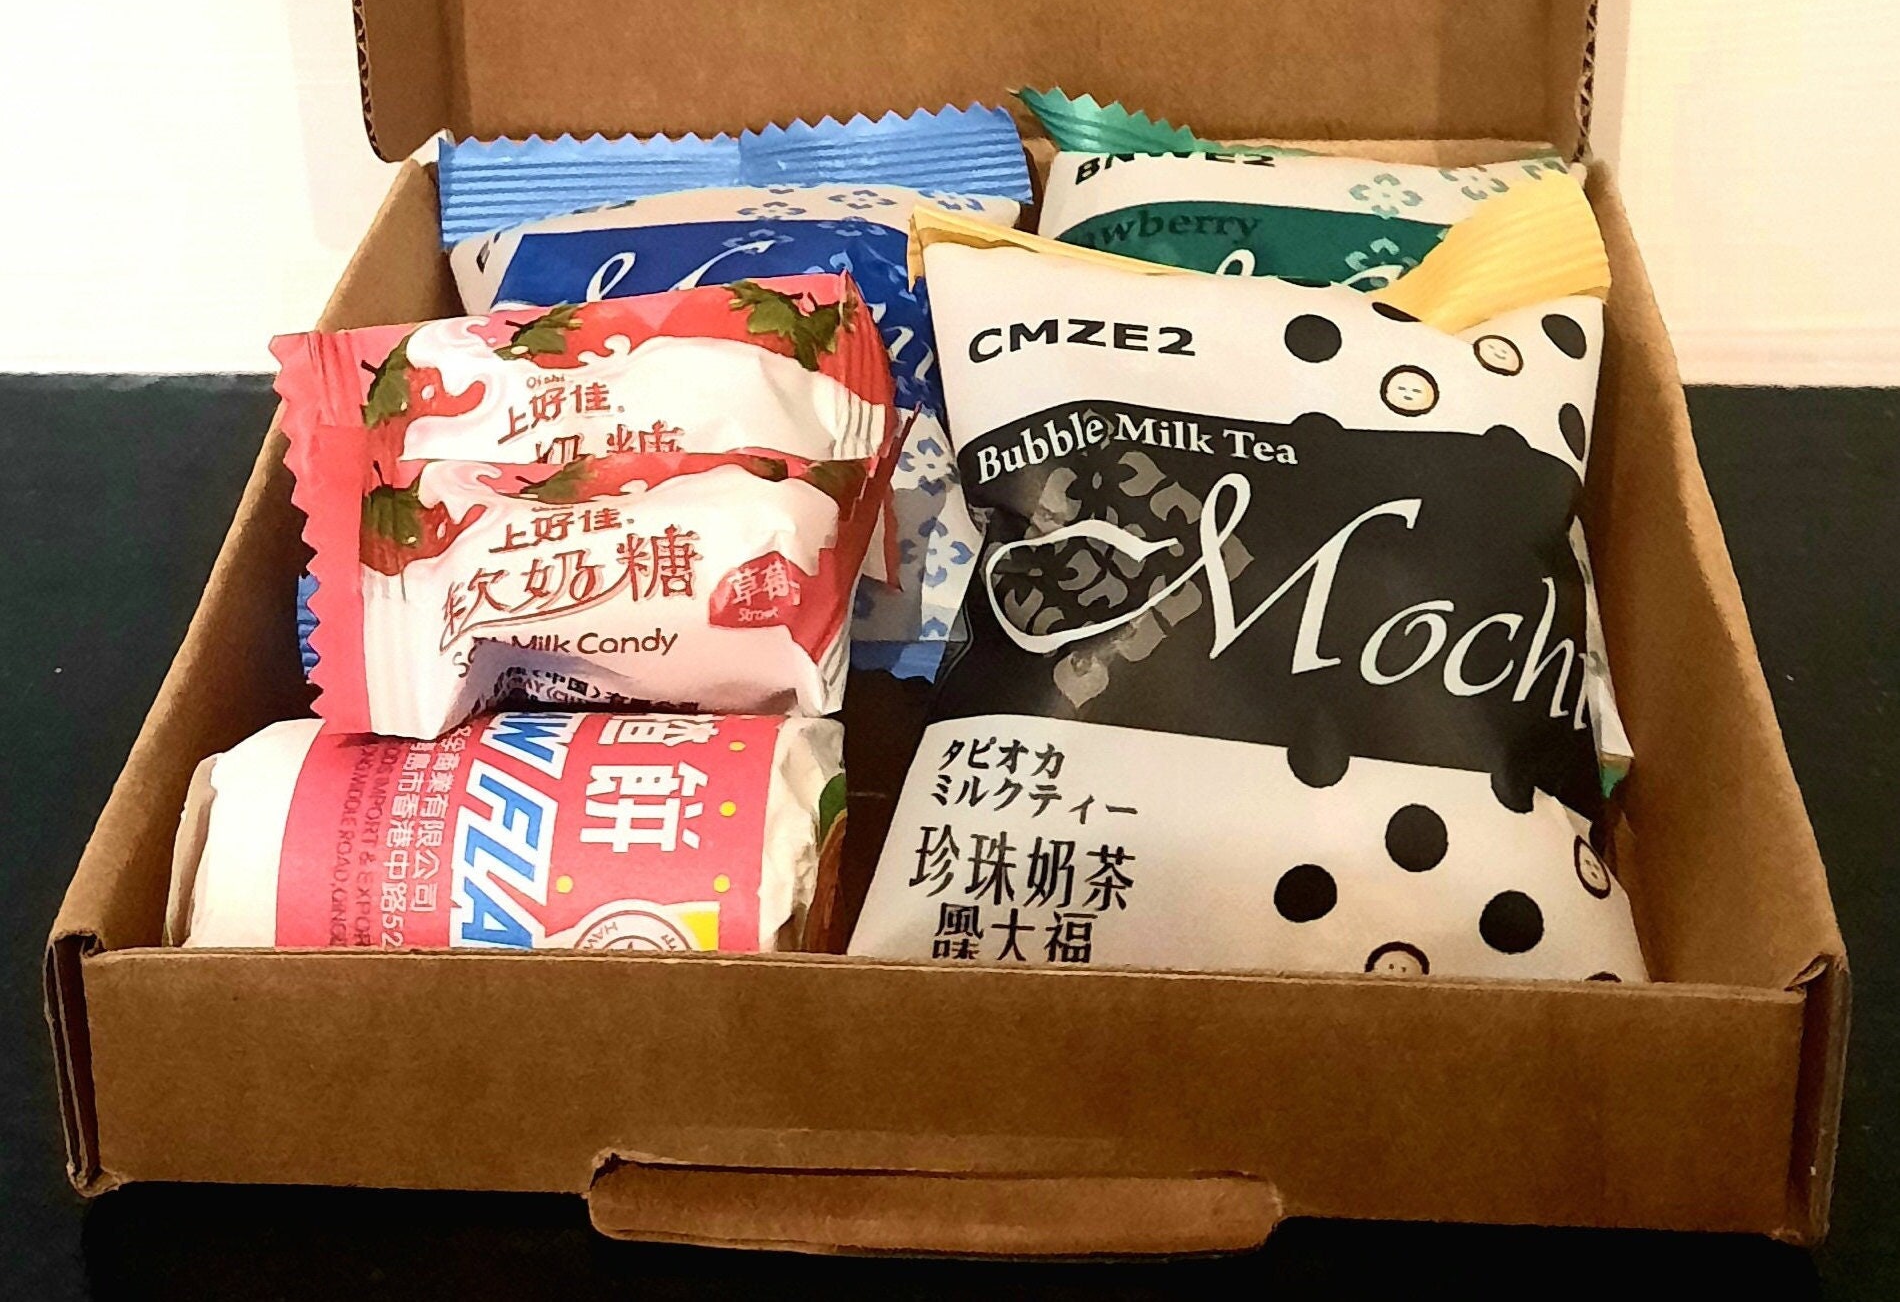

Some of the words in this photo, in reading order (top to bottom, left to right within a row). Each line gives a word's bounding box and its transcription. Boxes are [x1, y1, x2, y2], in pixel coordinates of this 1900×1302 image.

[1086, 209, 1264, 247] wberry
[968, 318, 1197, 364] CMZE2
[497, 381, 612, 446] 上好佳
[976, 410, 1109, 486] Bubble
[1113, 411, 1215, 456] Milk
[1221, 428, 1299, 466] Tea
[488, 507, 623, 554] 上好佳
[576, 627, 679, 656] Candy
[937, 735, 1066, 780] タピオカ
[930, 773, 1139, 826] ミルクティー
[908, 823, 1137, 912] 珍珠奶茶
